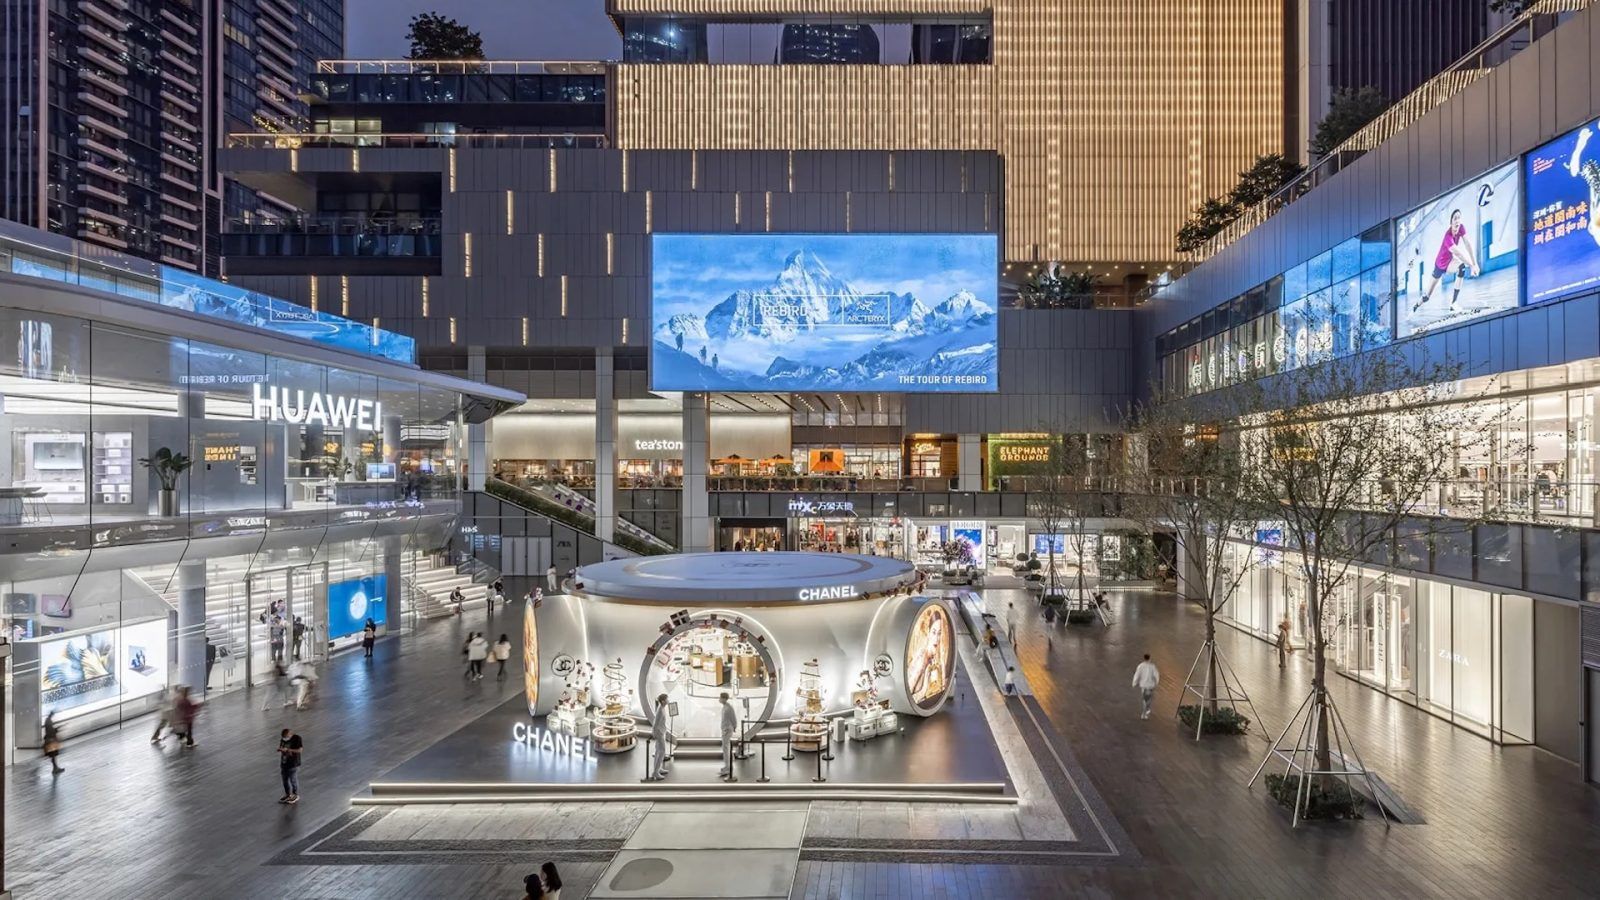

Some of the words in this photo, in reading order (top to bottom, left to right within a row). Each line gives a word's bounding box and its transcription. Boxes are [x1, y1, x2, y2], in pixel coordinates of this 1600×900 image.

[763, 305, 807, 317] REBIRD
[899, 375, 915, 384] THE
[917, 375, 940, 384] TOUR
[942, 375, 953, 384] OF
[955, 375, 987, 384] REBIRD
[253, 382, 381, 432] HUAWEI
[635, 439, 684, 450] tea'ston
[1000, 446, 1050, 455] ELEPHANT
[1000, 454, 1049, 462] GROUNDS
[799, 585, 859, 601] CHANEL
[513, 721, 598, 763] CHANEL
